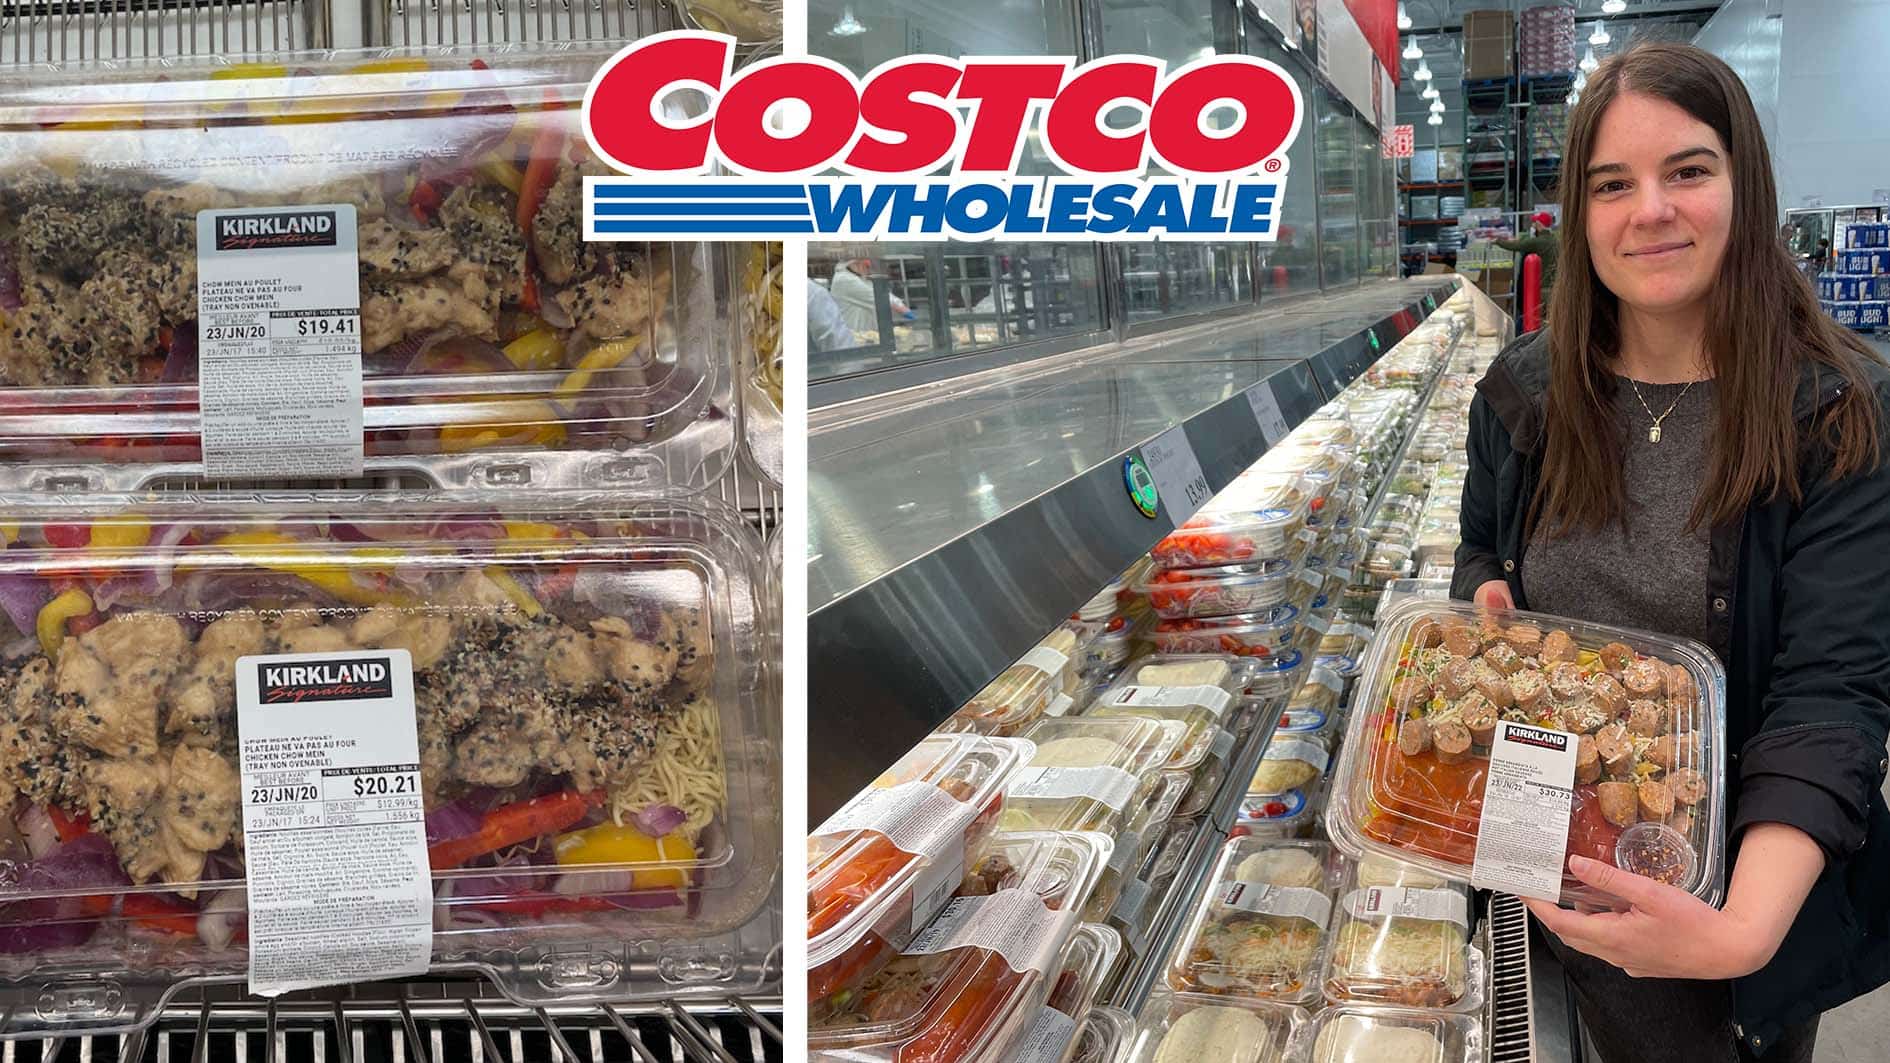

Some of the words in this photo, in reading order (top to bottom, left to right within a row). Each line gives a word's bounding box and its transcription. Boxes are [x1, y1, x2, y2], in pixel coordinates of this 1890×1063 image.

[223, 215, 331, 236] KIRKLAND
[223, 234, 331, 250] Signature
[254, 278, 282, 286] POULET
[202, 288, 234, 296] PLATEAU
[202, 296, 232, 304] CHICKEN
[202, 304, 223, 312] (TRAY
[241, 301, 280, 310] OVENABLE)
[206, 326, 266, 340] 23/JN/20
[298, 318, 354, 336] $19.41
[1185, 477, 1209, 507] 13.99
[266, 663, 386, 687] KIRKLAND
[266, 684, 387, 704] Signature
[1508, 726, 1566, 745] KIRKLAND
[245, 744, 280, 753] PLATEAU
[336, 740, 356, 748] FOUR
[246, 752, 279, 762] CHICKEN
[281, 752, 304, 760] CHOW
[306, 750, 325, 758] MEIN
[246, 762, 268, 772] (TRAY
[289, 758, 333, 768] OVENABLE)
[354, 776, 415, 798] $20.21
[1491, 780, 1522, 791] 23/JN/22
[251, 786, 318, 803] 23/JN/20
[1539, 788, 1570, 800] $30.73
[378, 799, 418, 808] $12.99/kg
[252, 817, 292, 828] 23/JN/17
